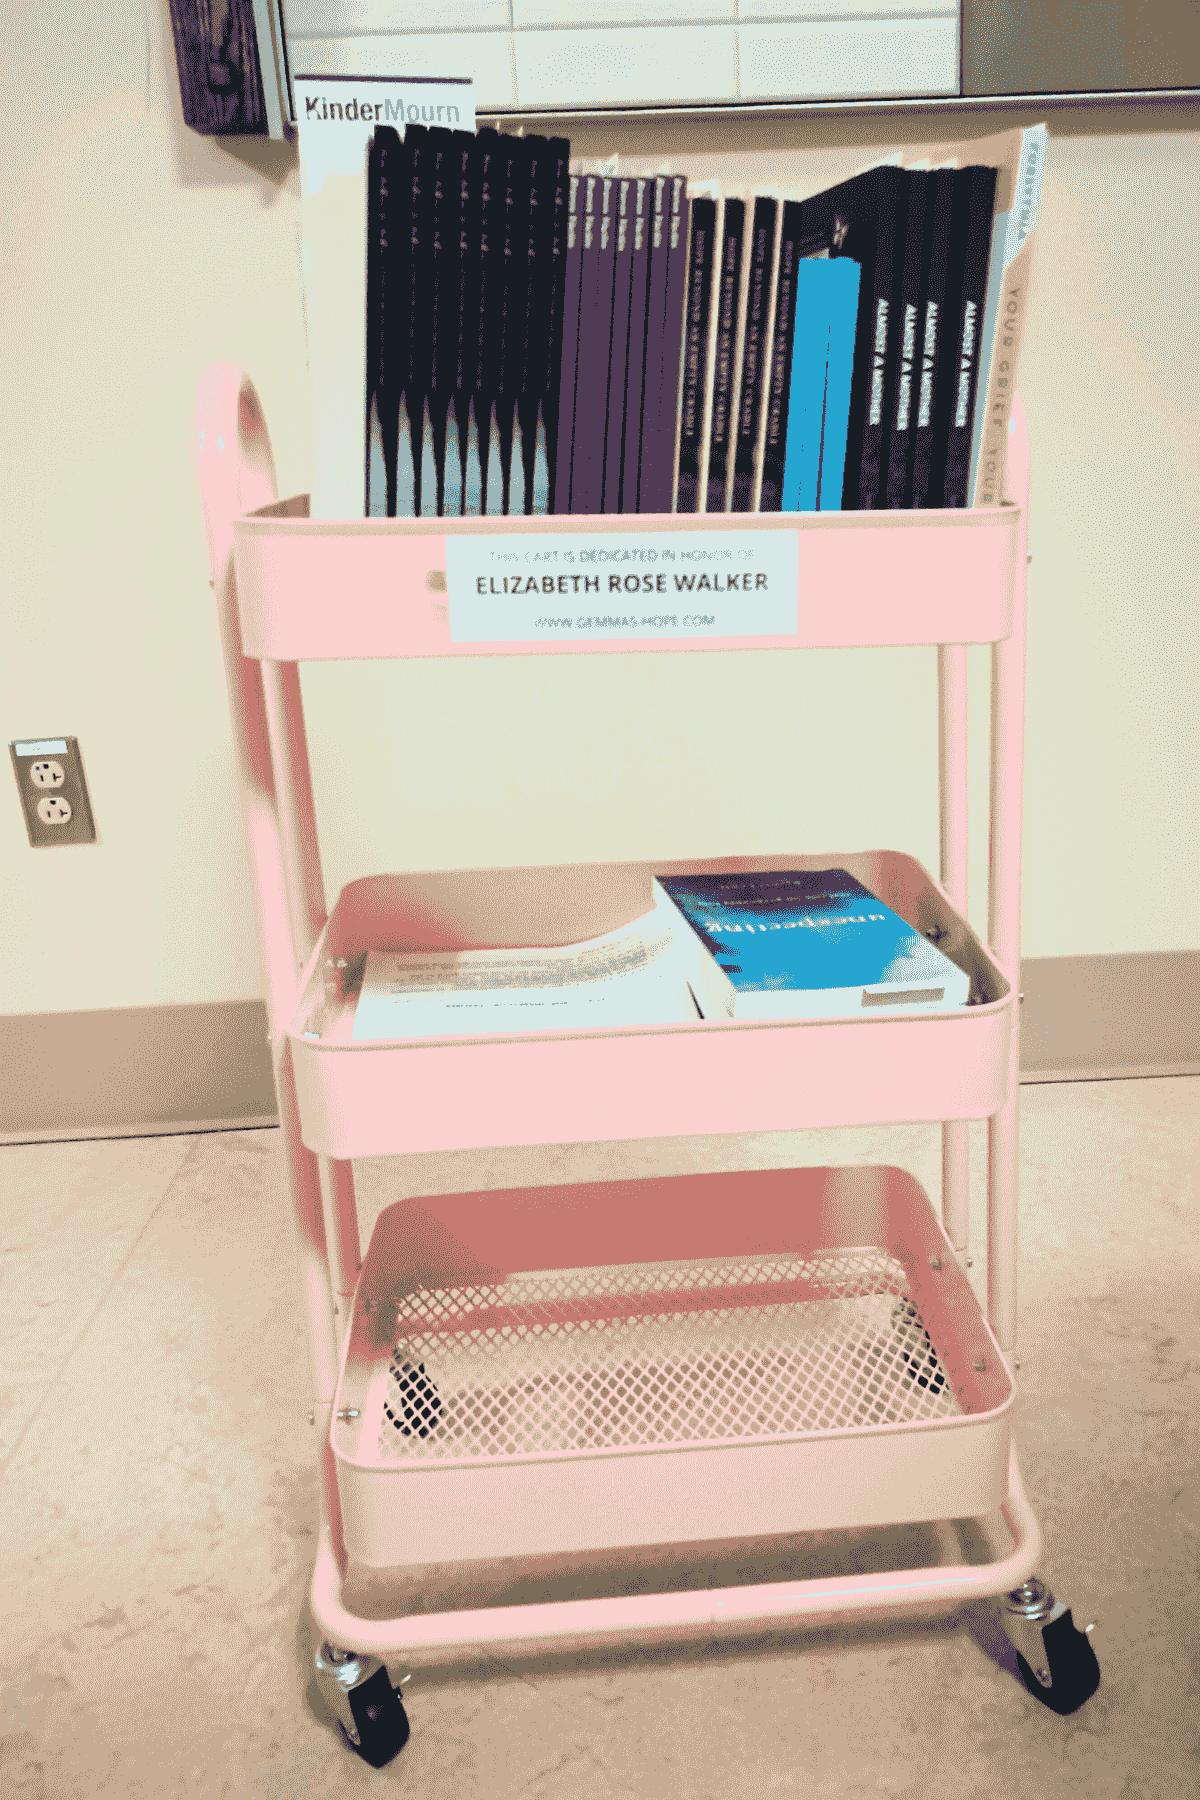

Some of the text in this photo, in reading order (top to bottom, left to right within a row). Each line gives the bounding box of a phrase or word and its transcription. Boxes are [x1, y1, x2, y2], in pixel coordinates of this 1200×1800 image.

[305, 96, 460, 122] KinderMourn
[1017, 142, 1040, 240] FORSYTHIA
[869, 298, 889, 426] ALMOST A MOTHER
[896, 304, 918, 431] ALMOST A MOTHER
[918, 301, 938, 427] ALMOST A MOTHER
[955, 300, 977, 428] ALMOST A MOTHER
[982, 288, 1020, 502] YOUR GRIEF YOUR
[476, 573, 769, 594] ELIZABETH ROSE WALKER
[525, 551, 558, 563] CART
[564, 550, 576, 563] IS
[580, 549, 658, 563] DEDICATED
[662, 549, 675, 562] IN
[681, 549, 732, 562] HONOR
[737, 549, 754, 561] OF
[534, 615, 716, 629] WWW.GEMMAS-HOPE.COM
[704, 913, 886, 933] unexpecting
